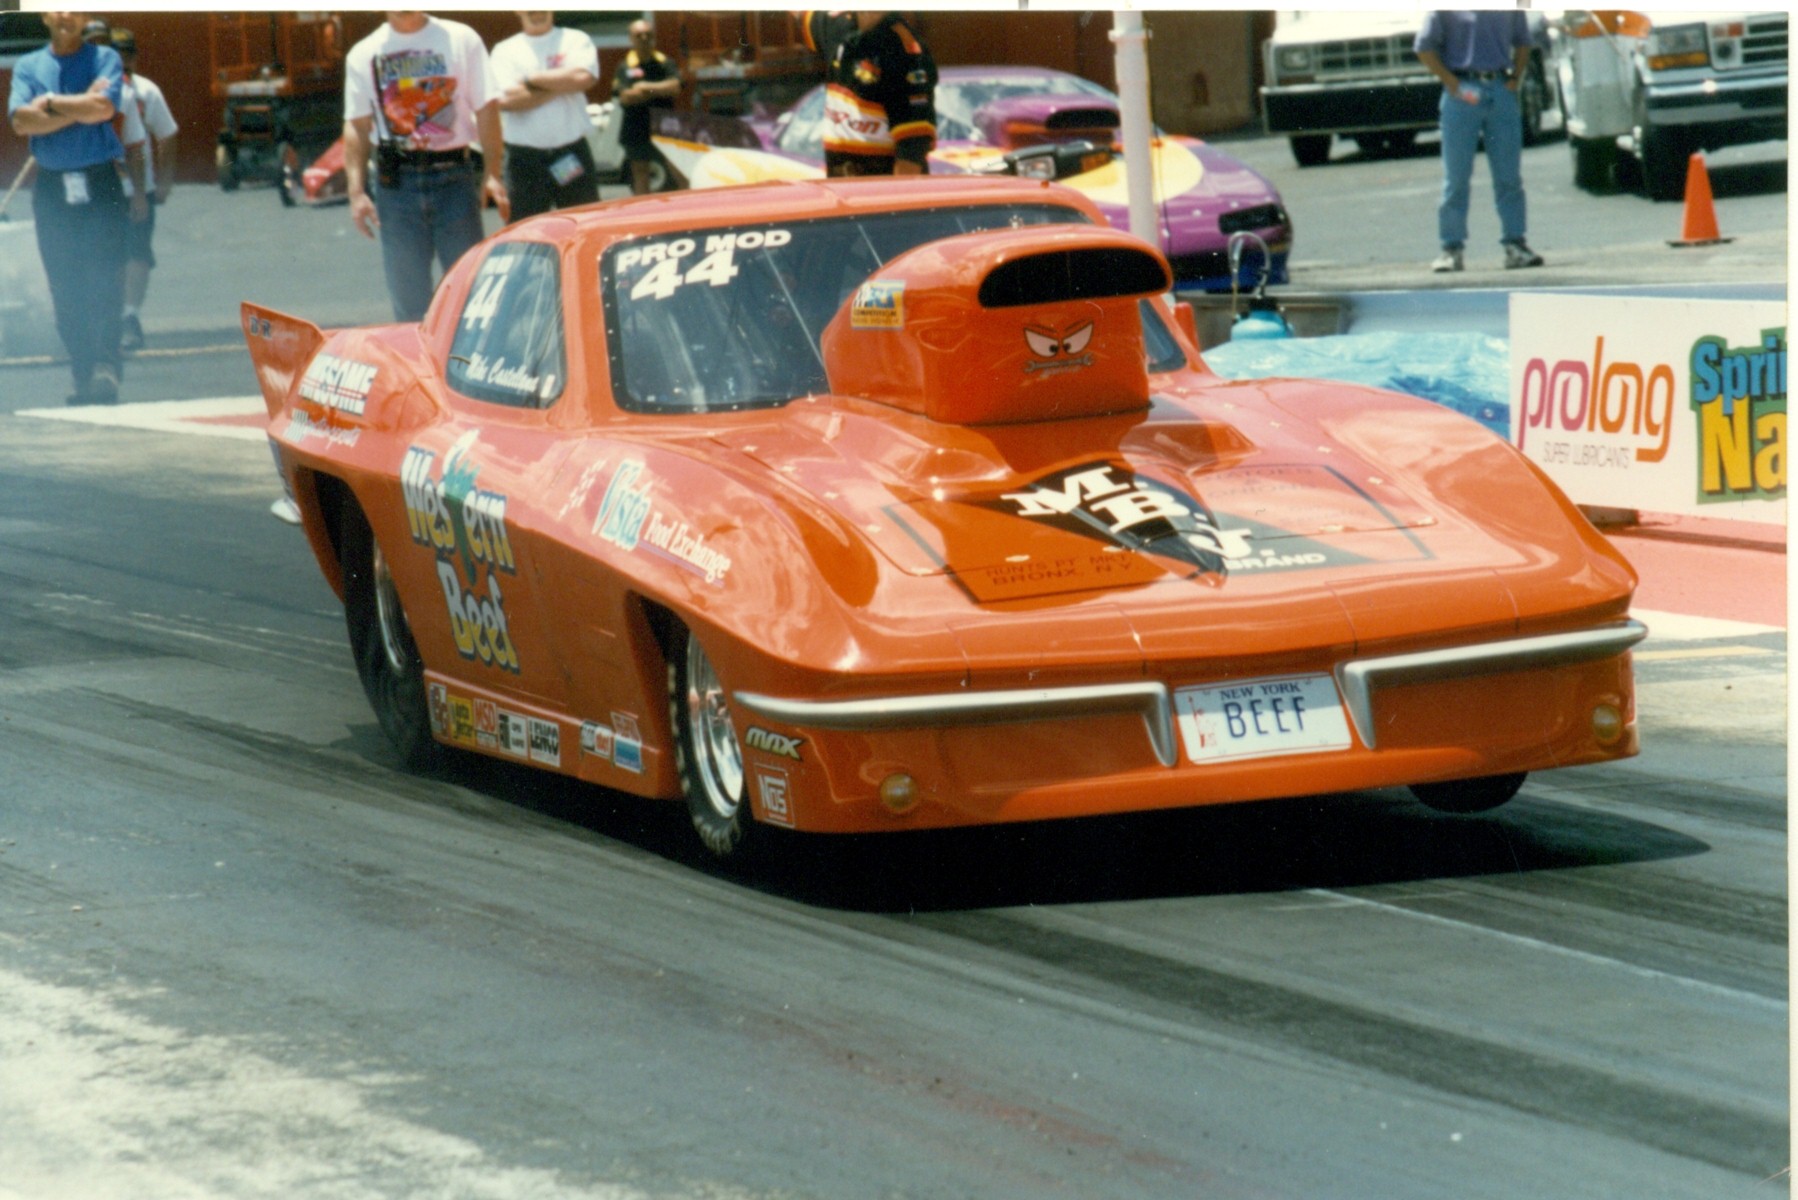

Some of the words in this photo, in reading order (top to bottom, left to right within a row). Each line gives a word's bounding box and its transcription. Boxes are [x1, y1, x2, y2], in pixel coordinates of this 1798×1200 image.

[616, 238, 696, 274] PRO
[705, 230, 791, 253] MOD
[631, 250, 739, 300] 44
[463, 274, 508, 330] 44
[1517, 336, 1675, 463] prolong
[1693, 335, 1787, 415] Spri
[1543, 441, 1571, 463] SUPER
[1573, 444, 1631, 468] LUBRICANTS
[591, 459, 652, 552] Vista
[644, 511, 679, 550] Food
[668, 523, 732, 584] Exchange
[1222, 552, 1327, 570] BRAND
[435, 552, 520, 675] Beef
[1218, 686, 1254, 701] NEW
[1259, 682, 1302, 696] YORK
[1223, 696, 1306, 738] BEEF
